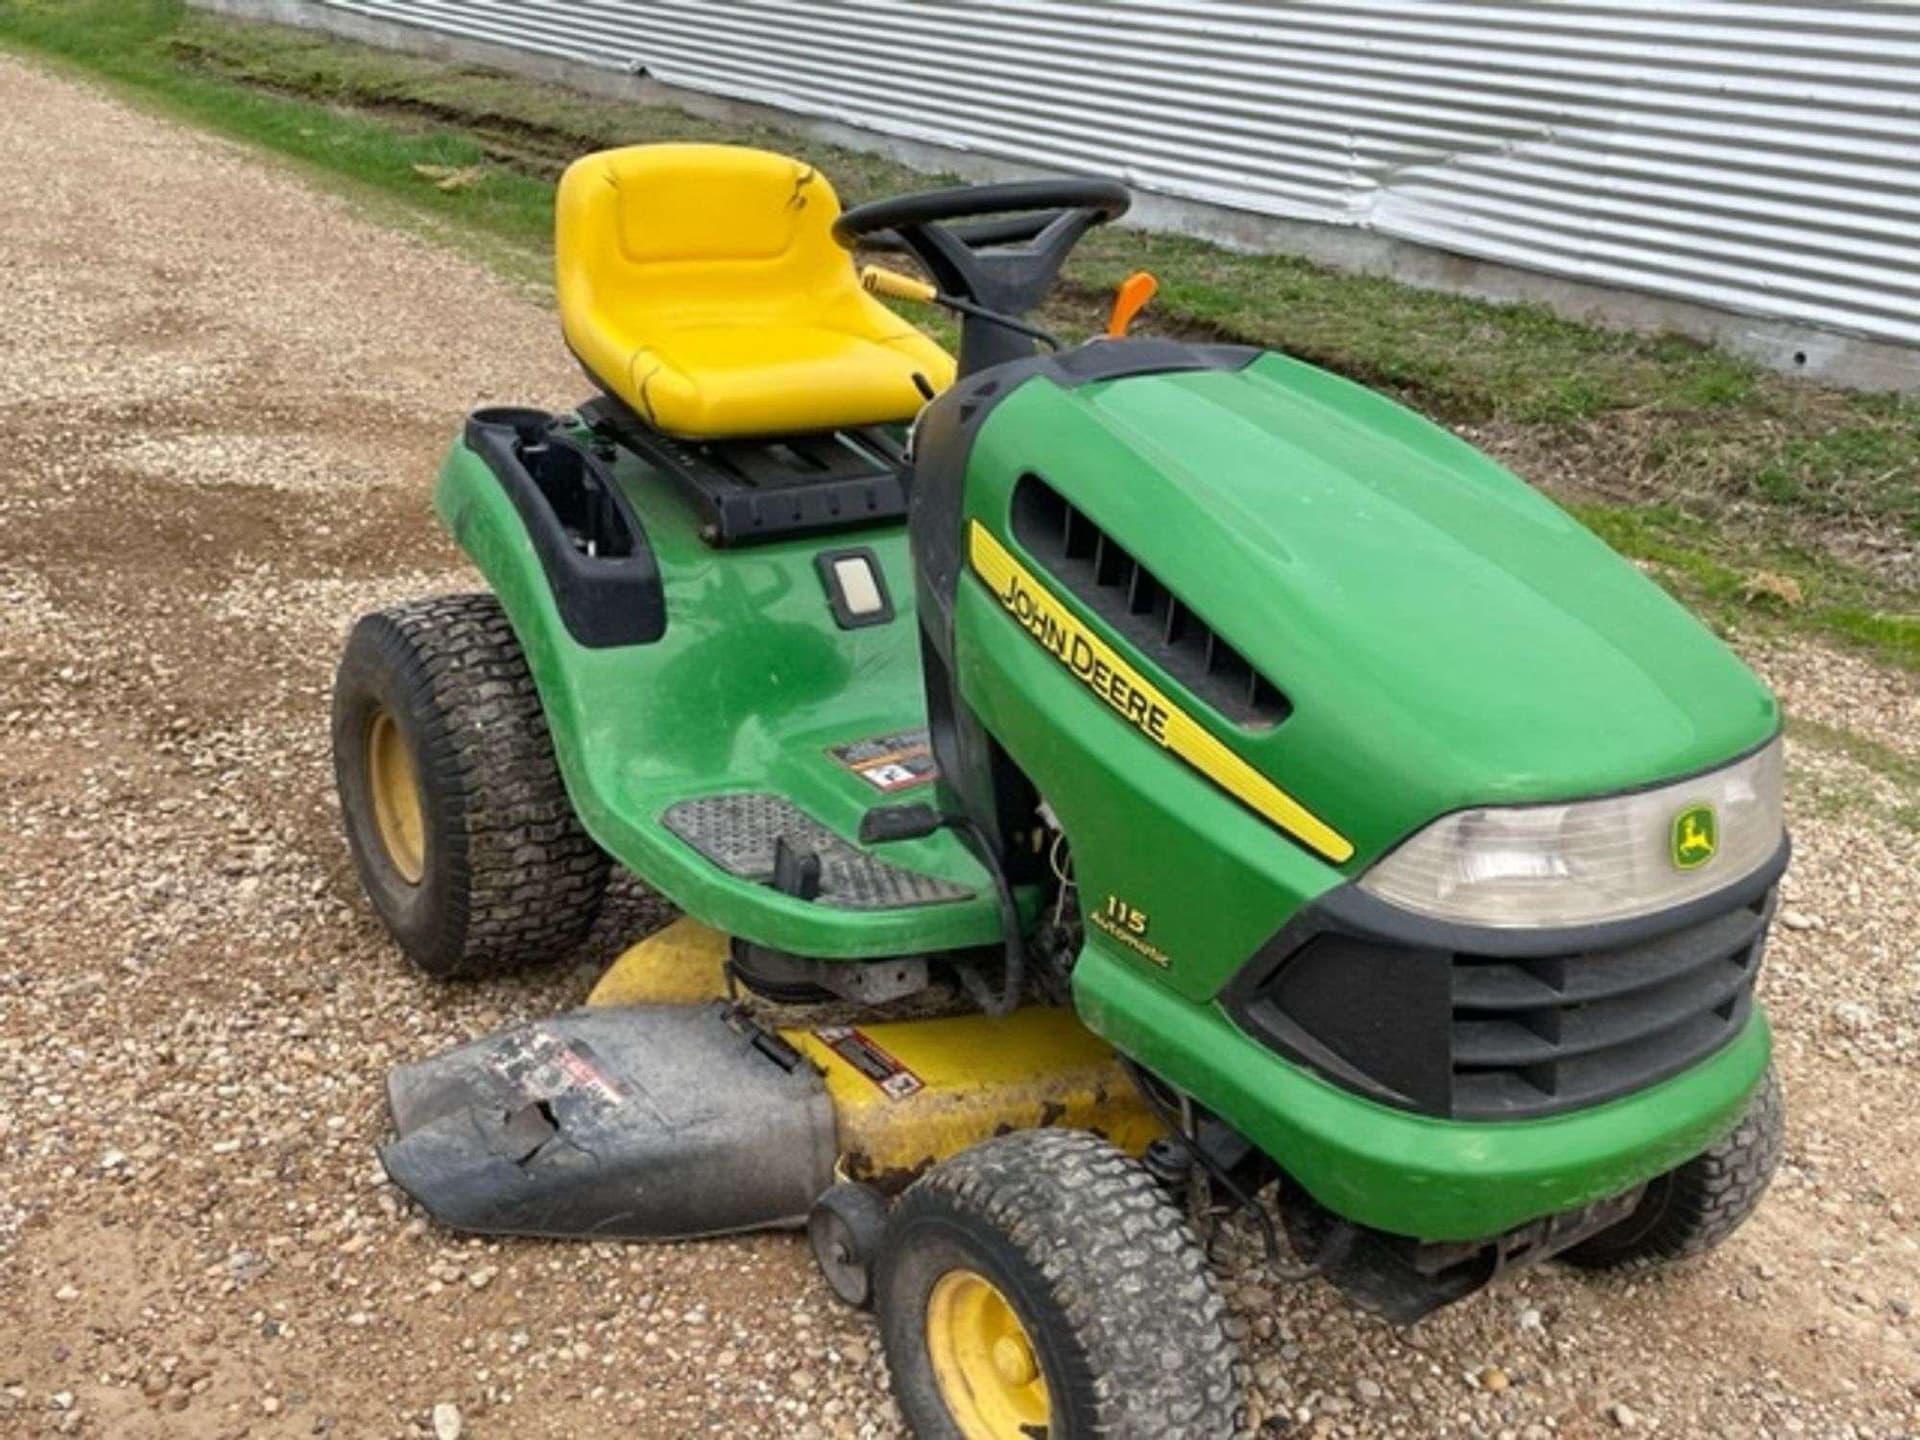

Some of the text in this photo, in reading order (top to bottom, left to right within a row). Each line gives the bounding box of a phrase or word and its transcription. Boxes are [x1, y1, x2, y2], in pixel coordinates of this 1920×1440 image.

[1001, 576, 1169, 741] JOHN DEERE
[1107, 895, 1147, 933] 115
